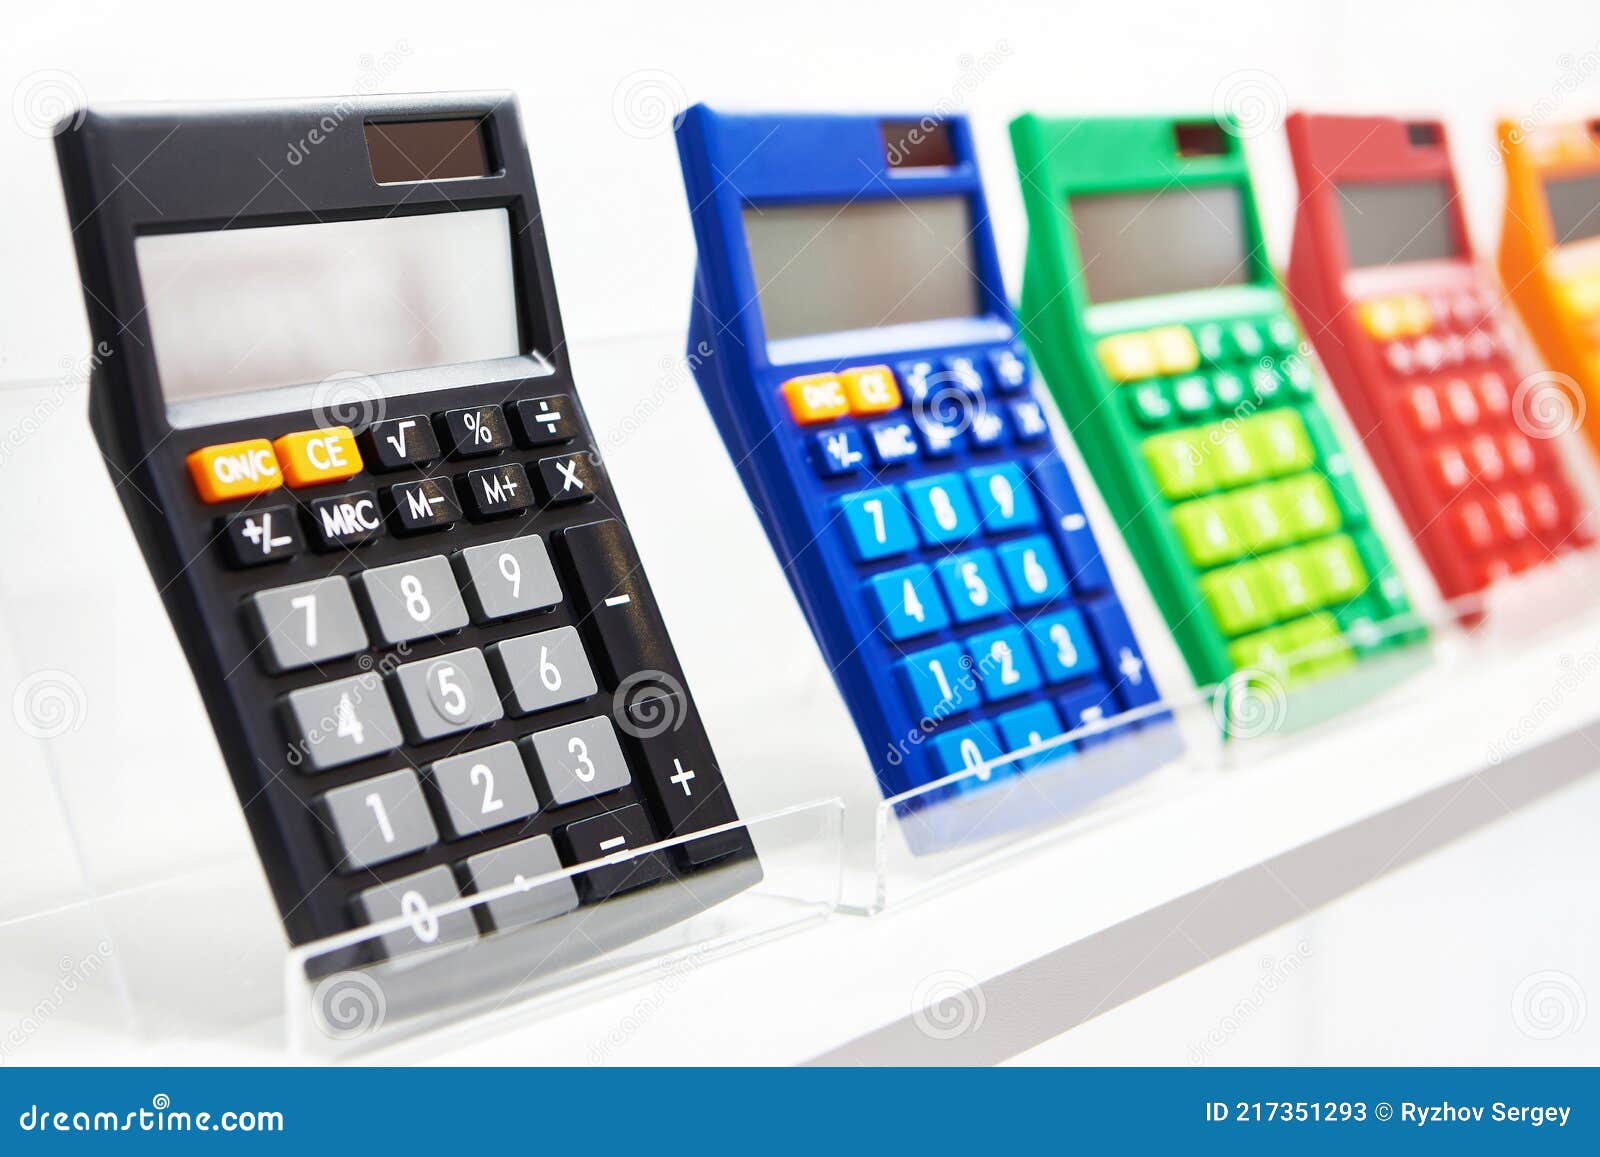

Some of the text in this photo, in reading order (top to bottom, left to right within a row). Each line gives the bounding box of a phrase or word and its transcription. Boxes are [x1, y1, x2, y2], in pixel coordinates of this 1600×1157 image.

[213, 448, 276, 482] ON/C
[306, 437, 347, 470] CE
[320, 499, 379, 538] MRC
[482, 475, 518, 505] M+
[863, 499, 886, 543] 7
[929, 486, 957, 531] 8
[989, 474, 1014, 518] 9
[292, 594, 317, 646] 7
[400, 575, 431, 622] 8
[499, 554, 521, 598] 9
[903, 549, 1048, 622] 4 5 6
[337, 645, 562, 744] 4 5 6
[929, 659, 953, 702] 1
[991, 640, 1020, 685] 2
[1050, 623, 1077, 667] 3
[365, 793, 395, 843] 1
[470, 764, 503, 813] 2
[568, 737, 595, 782] 3
[401, 891, 438, 943] 0
